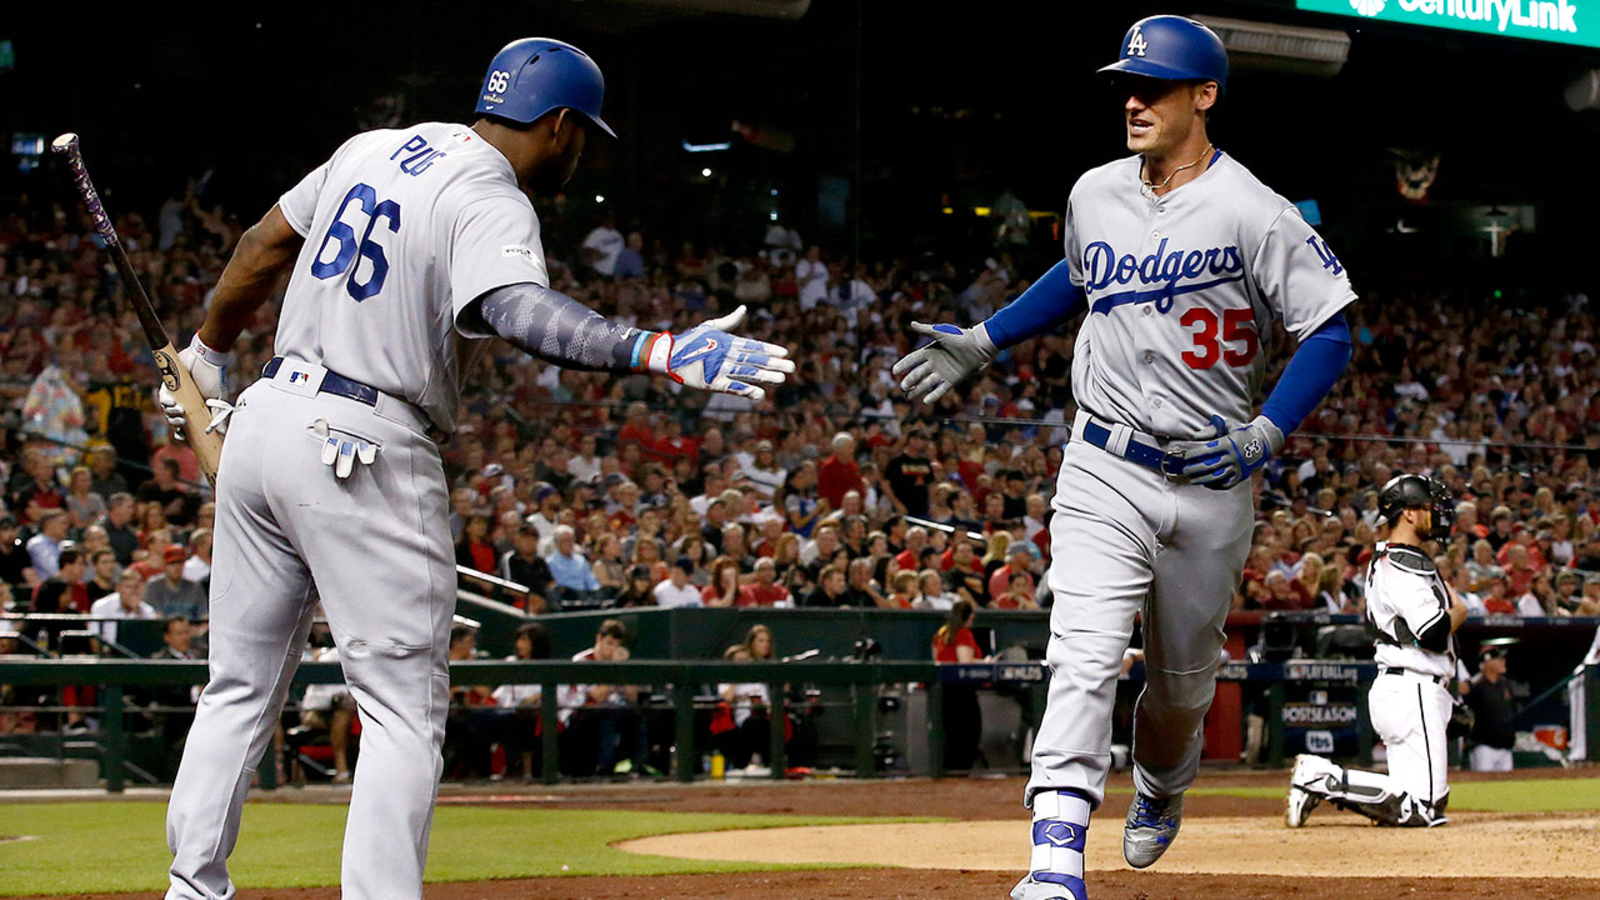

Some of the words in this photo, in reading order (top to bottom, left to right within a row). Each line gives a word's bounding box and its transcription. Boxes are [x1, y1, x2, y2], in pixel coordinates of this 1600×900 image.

[488, 70, 511, 94] 66
[311, 182, 401, 303] 66
[1084, 237, 1245, 314] Dodgers
[1180, 307, 1258, 370] 35
